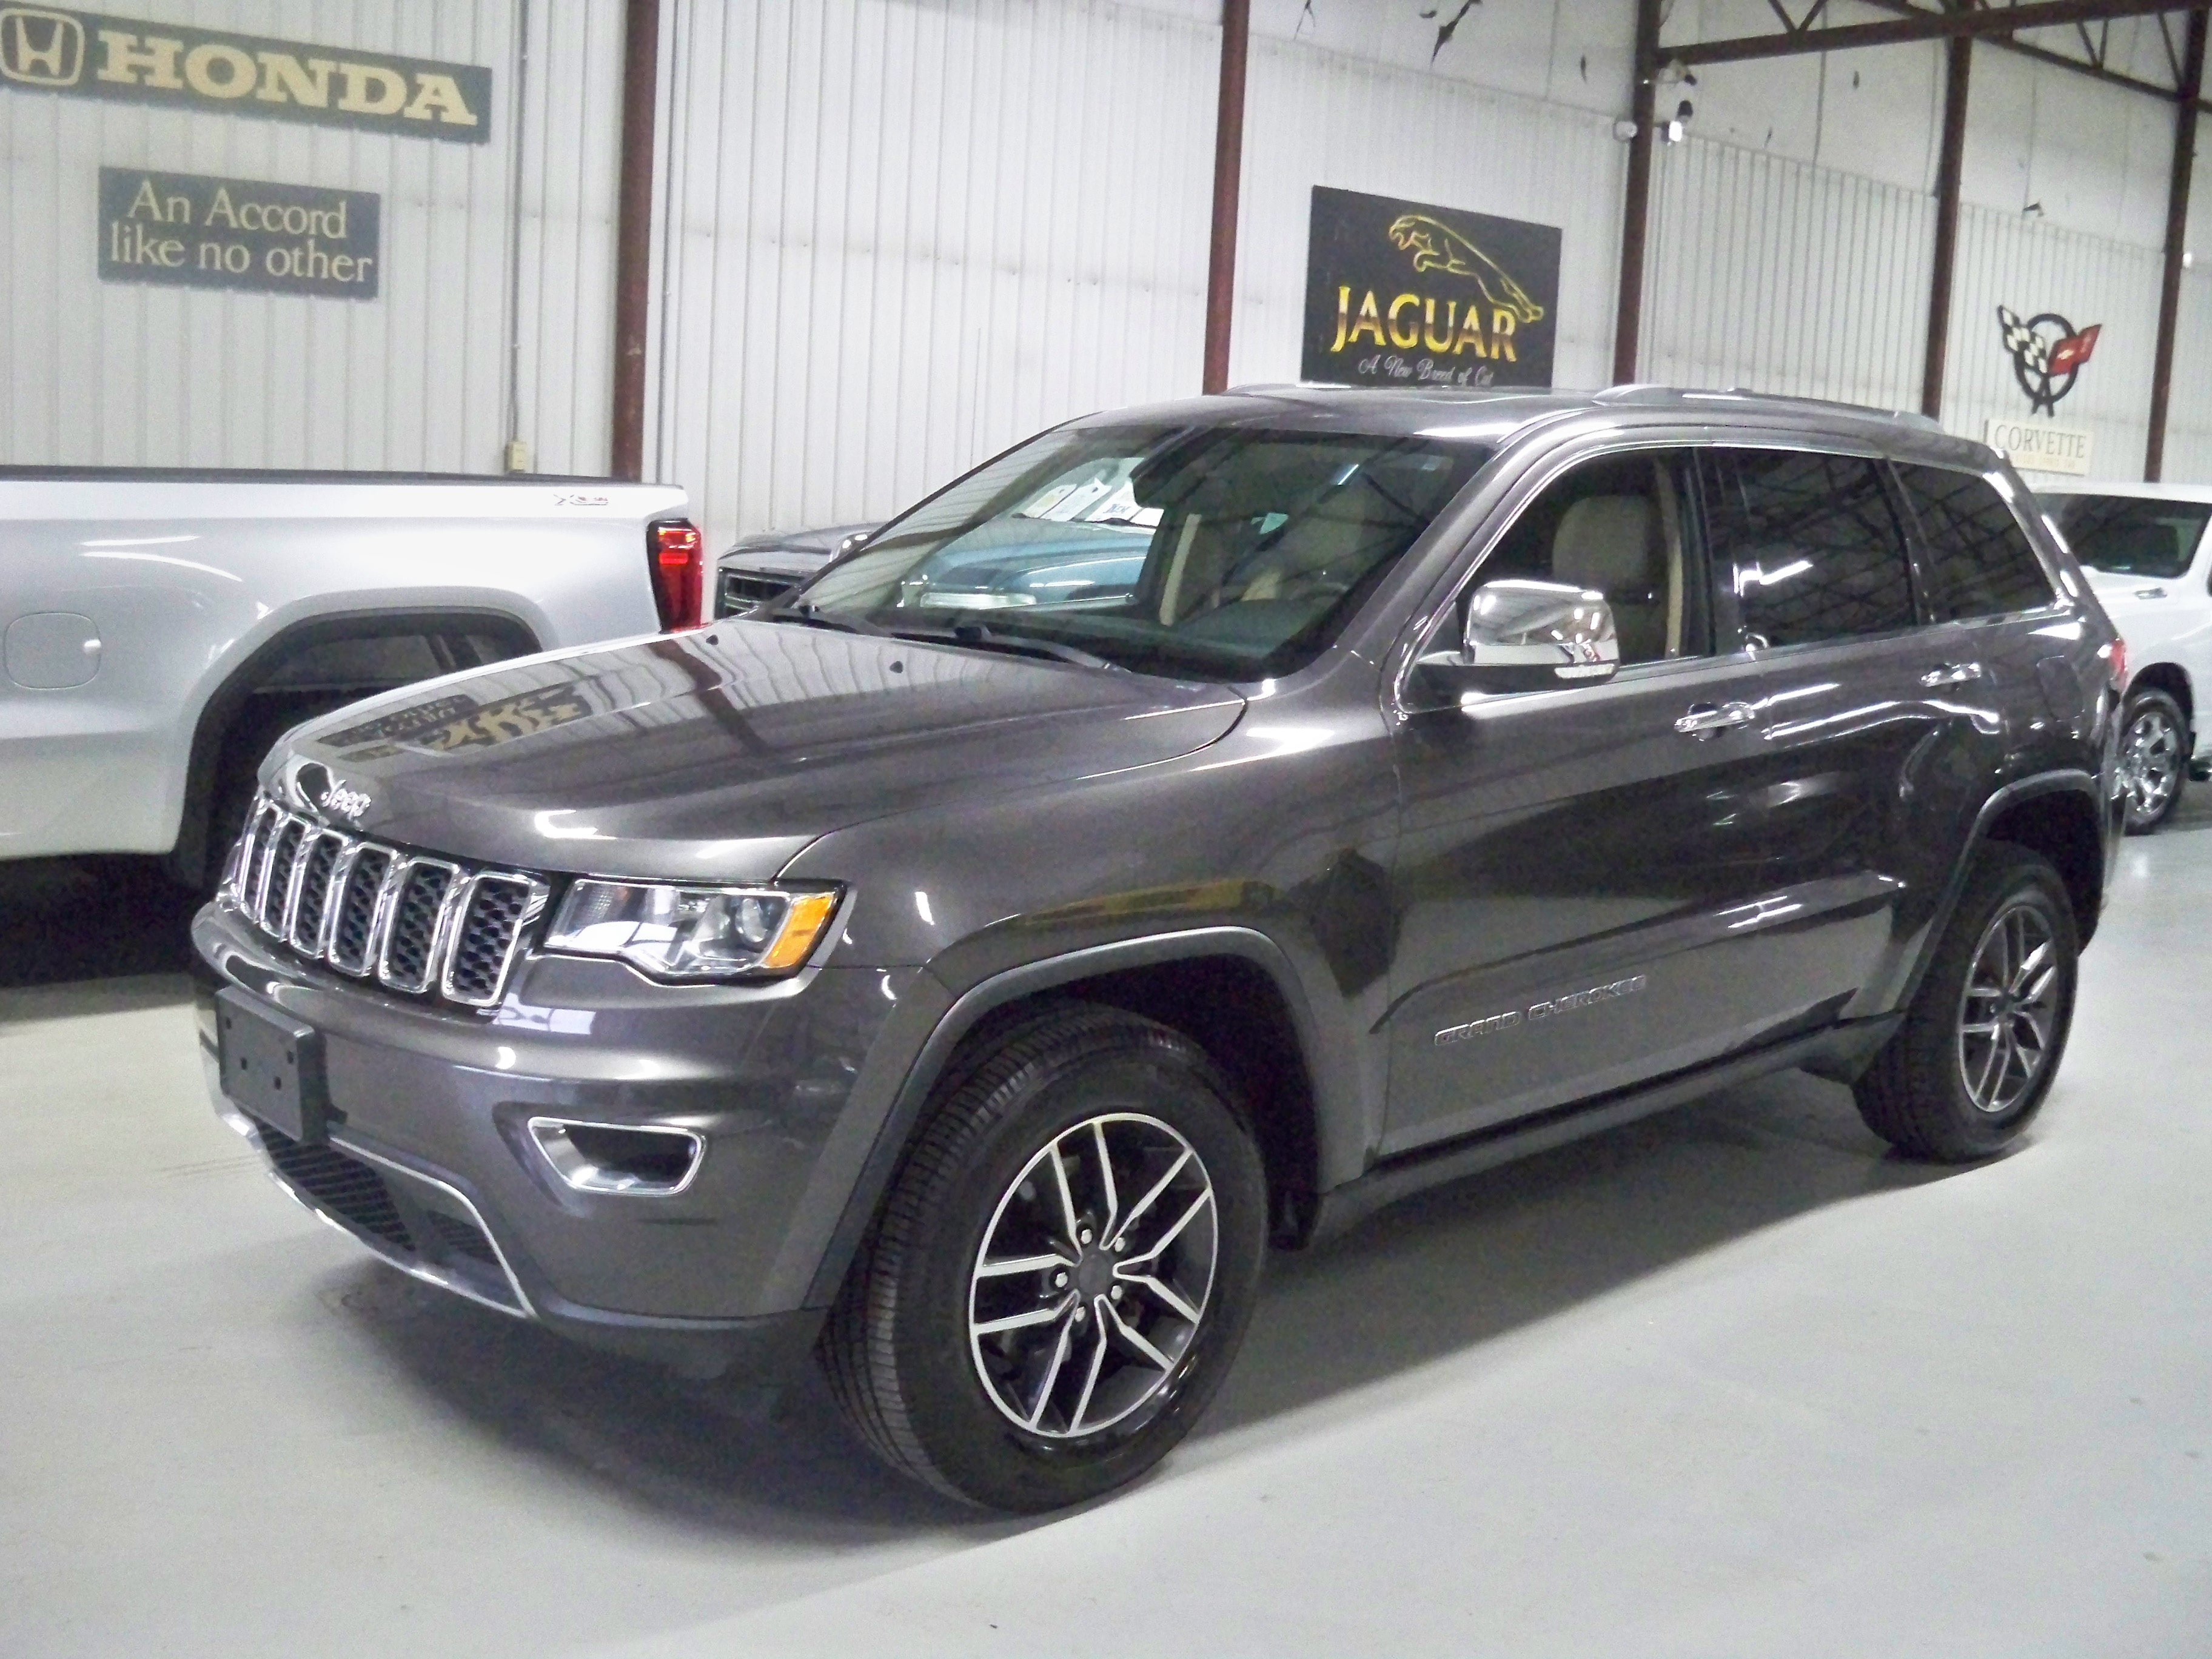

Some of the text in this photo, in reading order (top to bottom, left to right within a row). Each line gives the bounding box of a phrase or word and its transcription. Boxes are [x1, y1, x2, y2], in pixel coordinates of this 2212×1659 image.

[98, 30, 477, 126] HONDA
[128, 179, 347, 238] An Accord
[110, 223, 372, 283] like no other
[1330, 286, 1517, 362] JAGUAR
[1358, 354, 1381, 375] A
[1994, 424, 2086, 458] CORVETTE
[318, 779, 372, 820] Jeep
[1434, 974, 1646, 1045] GRAND CHEROKEE
